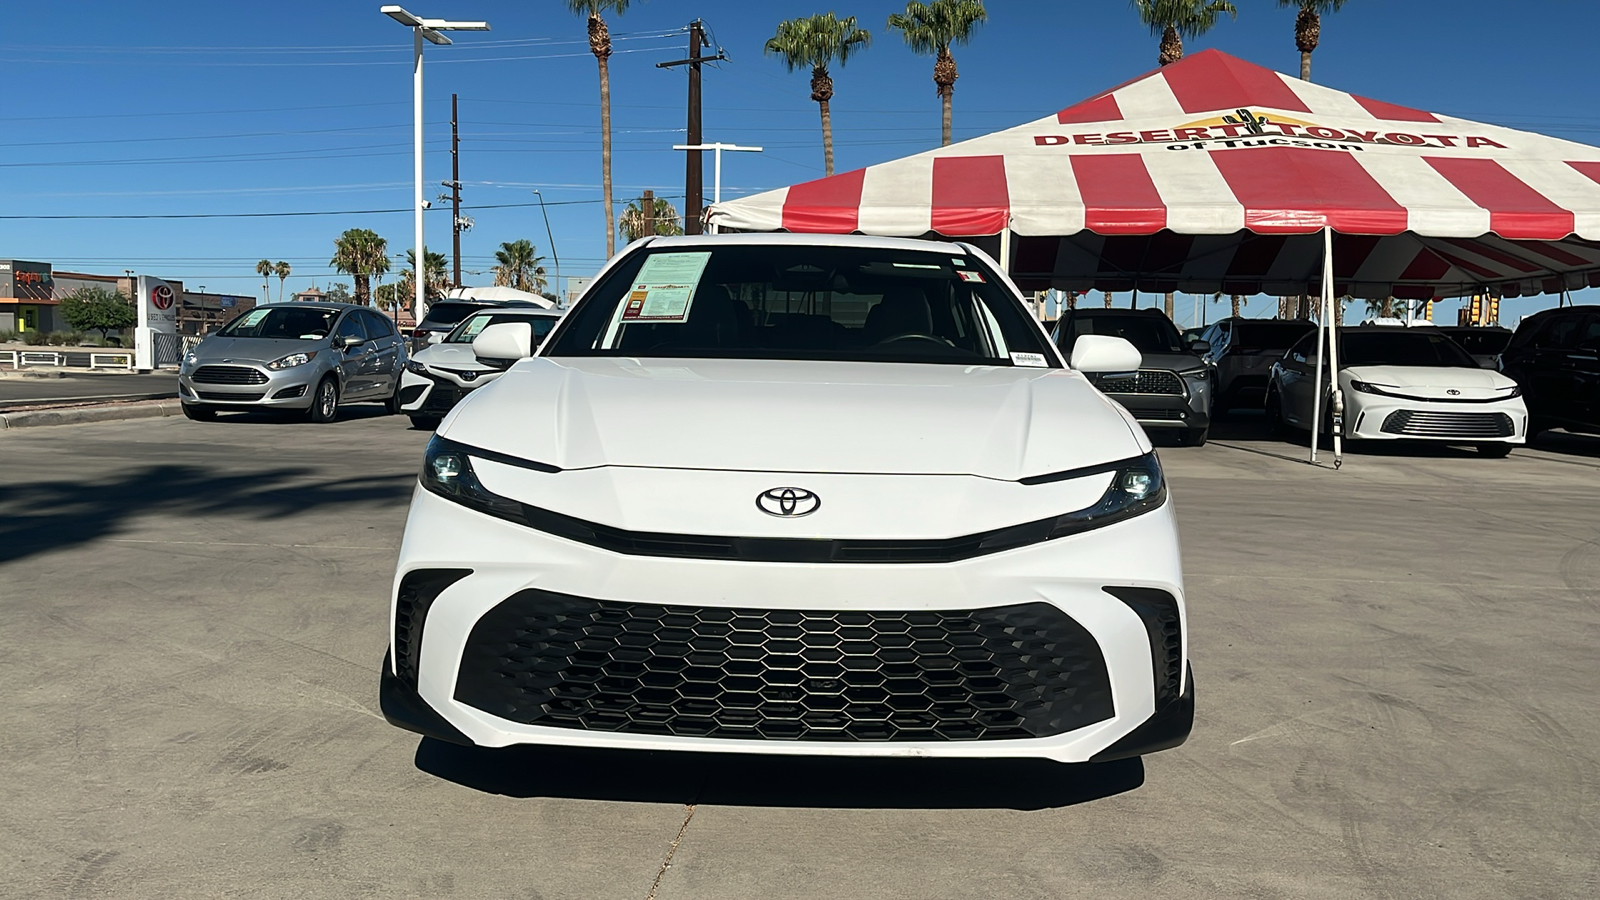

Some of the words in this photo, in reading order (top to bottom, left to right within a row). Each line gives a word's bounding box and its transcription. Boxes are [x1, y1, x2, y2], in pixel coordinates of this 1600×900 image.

[1034, 123, 1246, 146] DESERT
[1267, 121, 1508, 149] TOYOTA
[1166, 141, 1207, 151] of
[1214, 138, 1364, 152] Tucson
